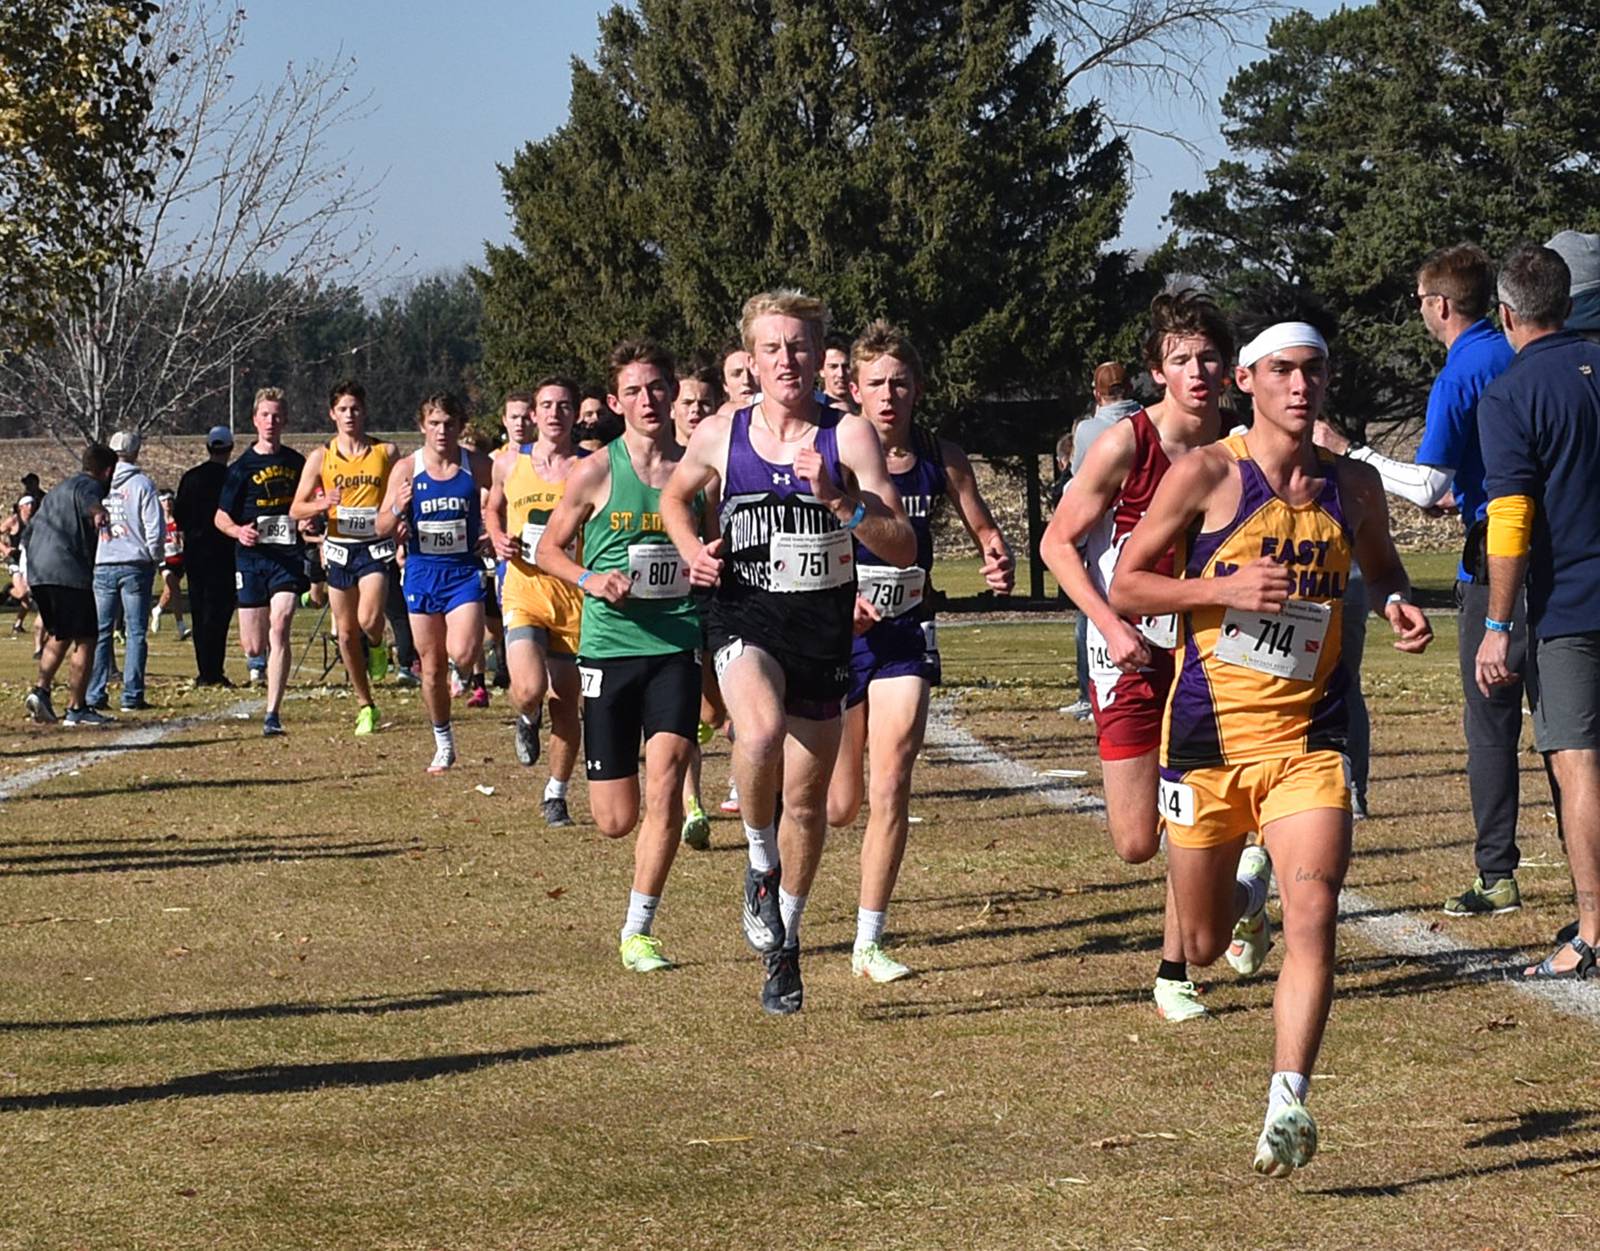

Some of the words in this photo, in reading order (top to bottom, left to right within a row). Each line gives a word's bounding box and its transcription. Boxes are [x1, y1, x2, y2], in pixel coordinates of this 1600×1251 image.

[333, 470, 381, 489] Regina
[514, 492, 543, 509] PRINCE
[349, 517, 366, 530] 779
[432, 531, 454, 547] 753
[1260, 537, 1330, 567] EAST
[649, 561, 678, 586] 807
[798, 552, 829, 577] 751
[872, 583, 904, 607] 730
[1254, 619, 1295, 658] 714
